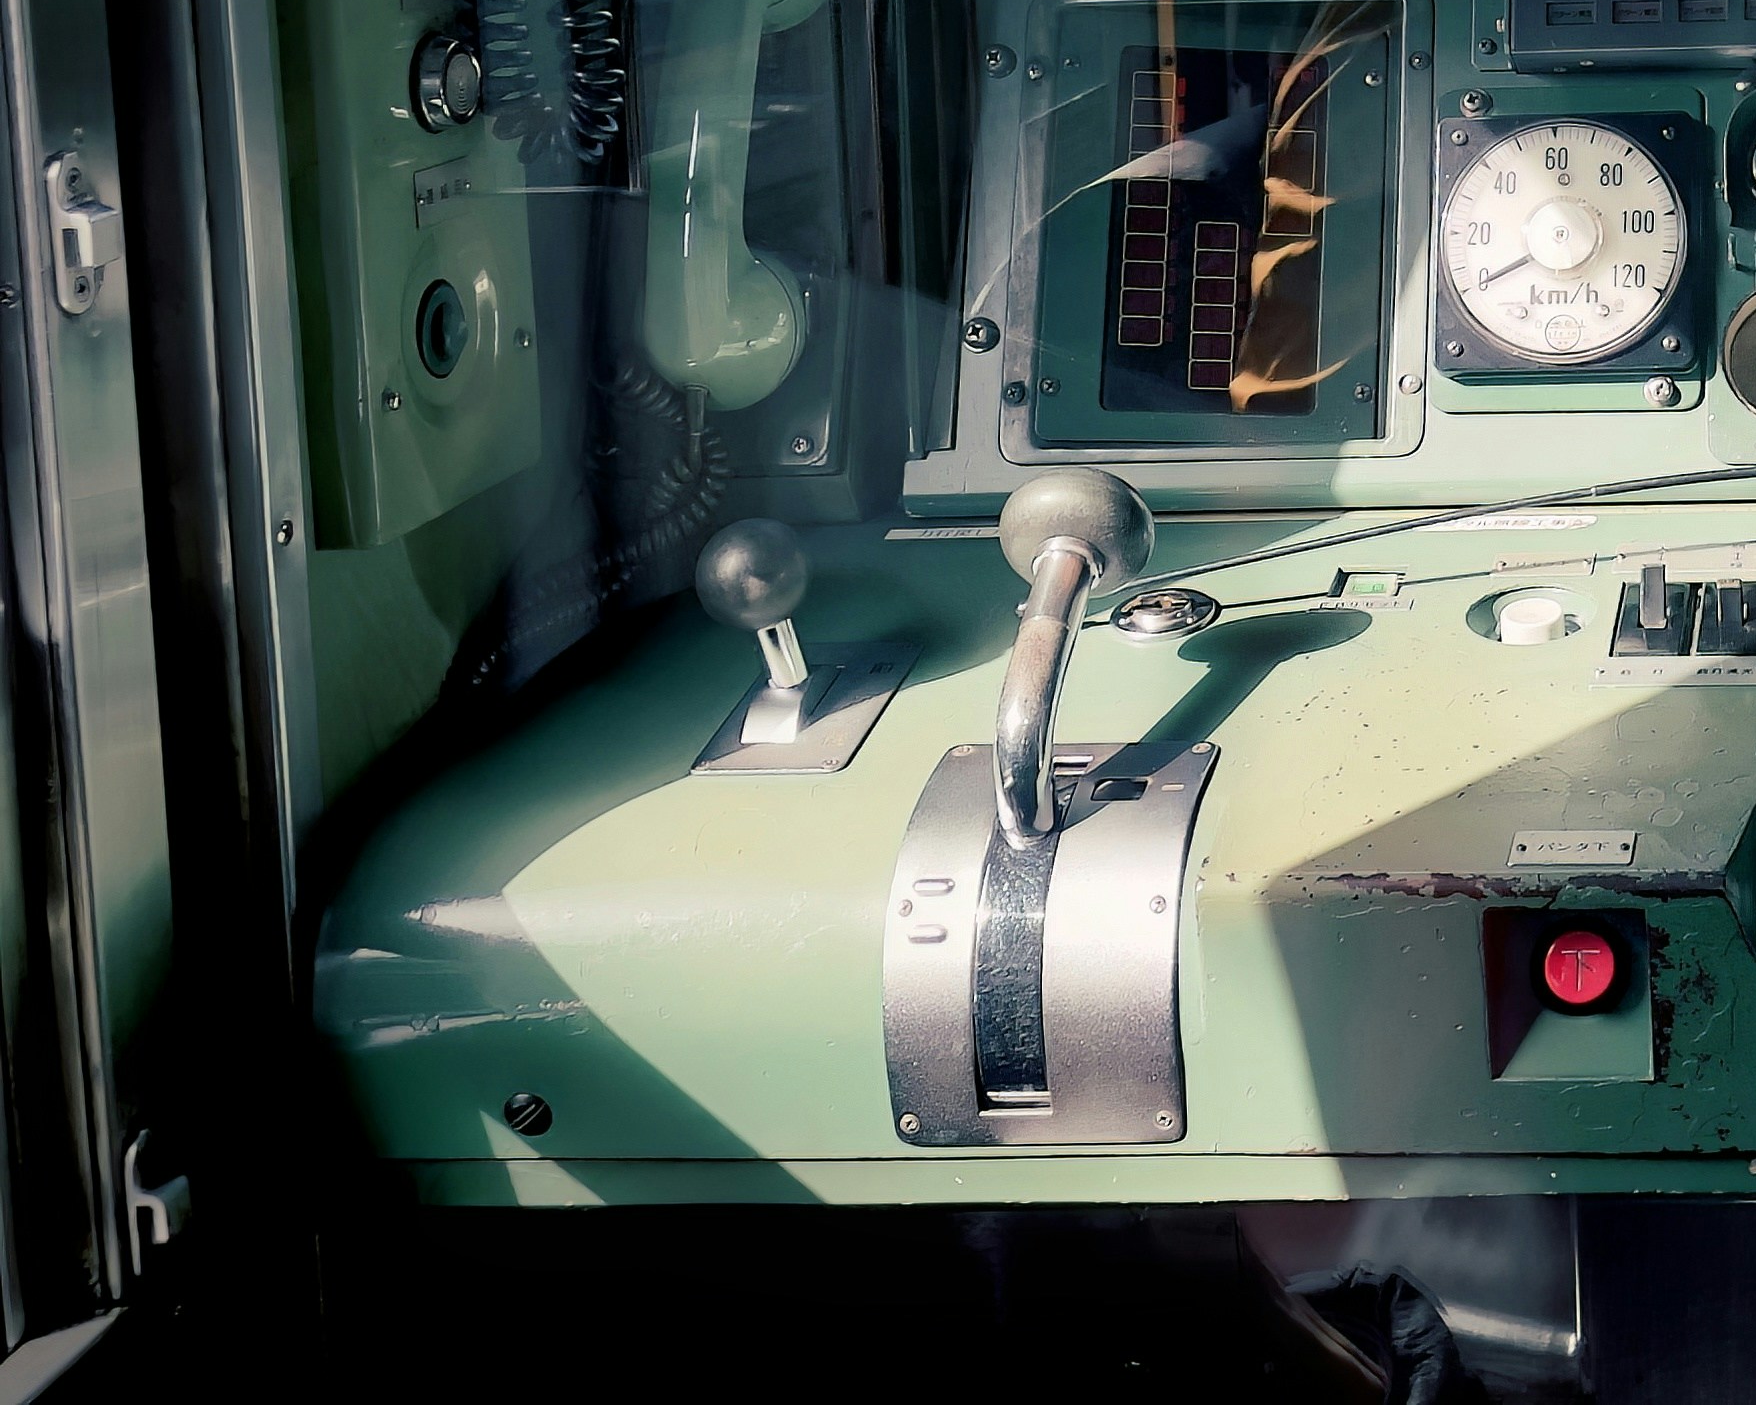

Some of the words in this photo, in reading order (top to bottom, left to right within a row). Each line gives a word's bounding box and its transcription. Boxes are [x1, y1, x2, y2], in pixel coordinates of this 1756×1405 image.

[1545, 147, 1569, 170] 60
[1494, 171, 1517, 195] 40
[1600, 163, 1623, 187] 80
[1622, 210, 1655, 233] 100
[1468, 222, 1491, 245] 20
[1478, 268, 1489, 291] 0
[1613, 264, 1646, 288] 120
[1529, 282, 1599, 305] km/h
[1538, 841, 1610, 852] パンタ下
